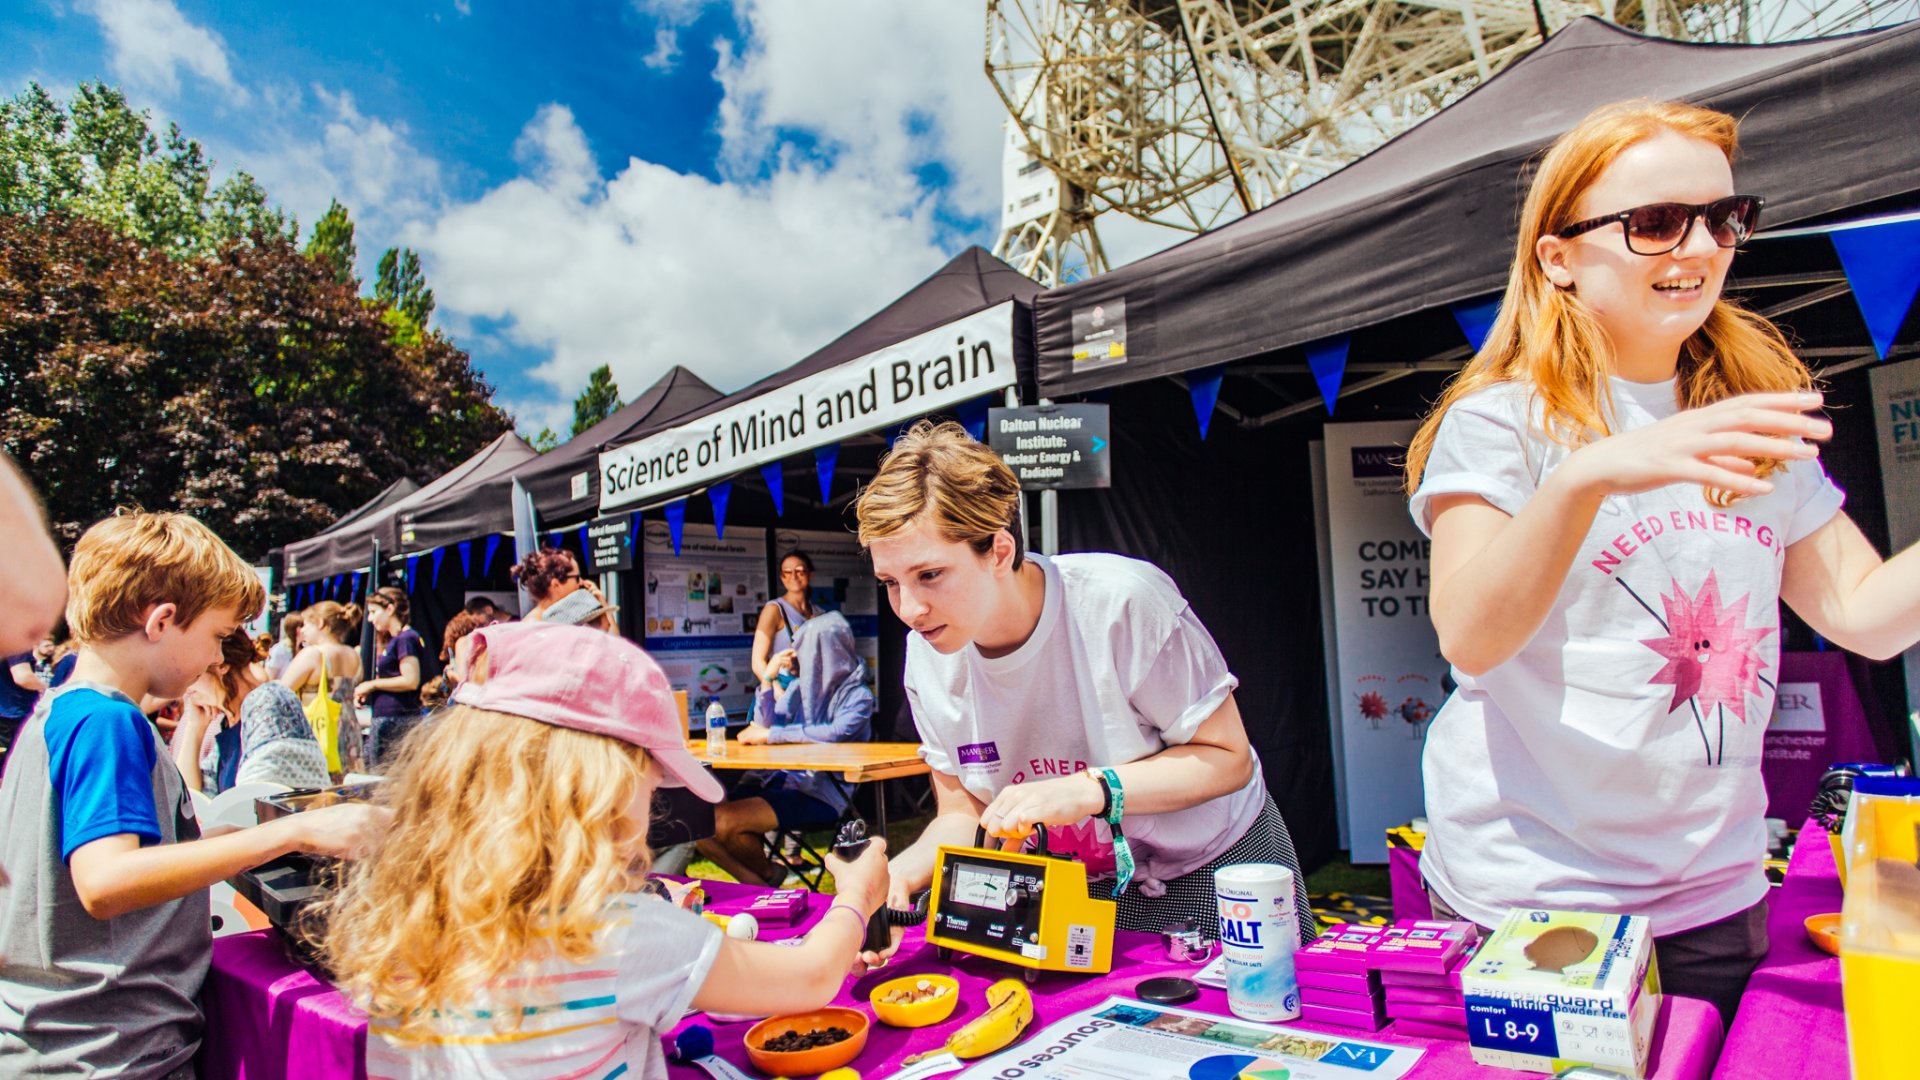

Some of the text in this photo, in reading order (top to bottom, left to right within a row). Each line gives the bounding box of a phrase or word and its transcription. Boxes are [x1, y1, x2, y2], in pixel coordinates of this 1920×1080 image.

[605, 447, 689, 496] Science
[696, 424, 722, 467] of
[731, 394, 806, 458] Mind
[816, 368, 878, 430] and
[891, 335, 995, 405] Brain
[1000, 416, 1083, 434] Dalton Nuclear
[1016, 435, 1068, 450] Institute:
[1002, 450, 1082, 465] Nuclear Energy &
[1020, 466, 1064, 479] Radiation
[1591, 515, 1665, 575] NEED
[1360, 567, 1409, 590] SAY
[1361, 596, 1400, 618] TO
[1029, 758, 1089, 776] ENER
[1220, 899, 1253, 920] LO
[946, 915, 969, 927] Thermo
[1219, 915, 1263, 944] SALT
[1470, 1004, 1507, 1016] comfort
[1510, 999, 1628, 1020] nitrile powder free
[1484, 1017, 1540, 1043] L 8-9
[1018, 1019, 1117, 1069] Sources
